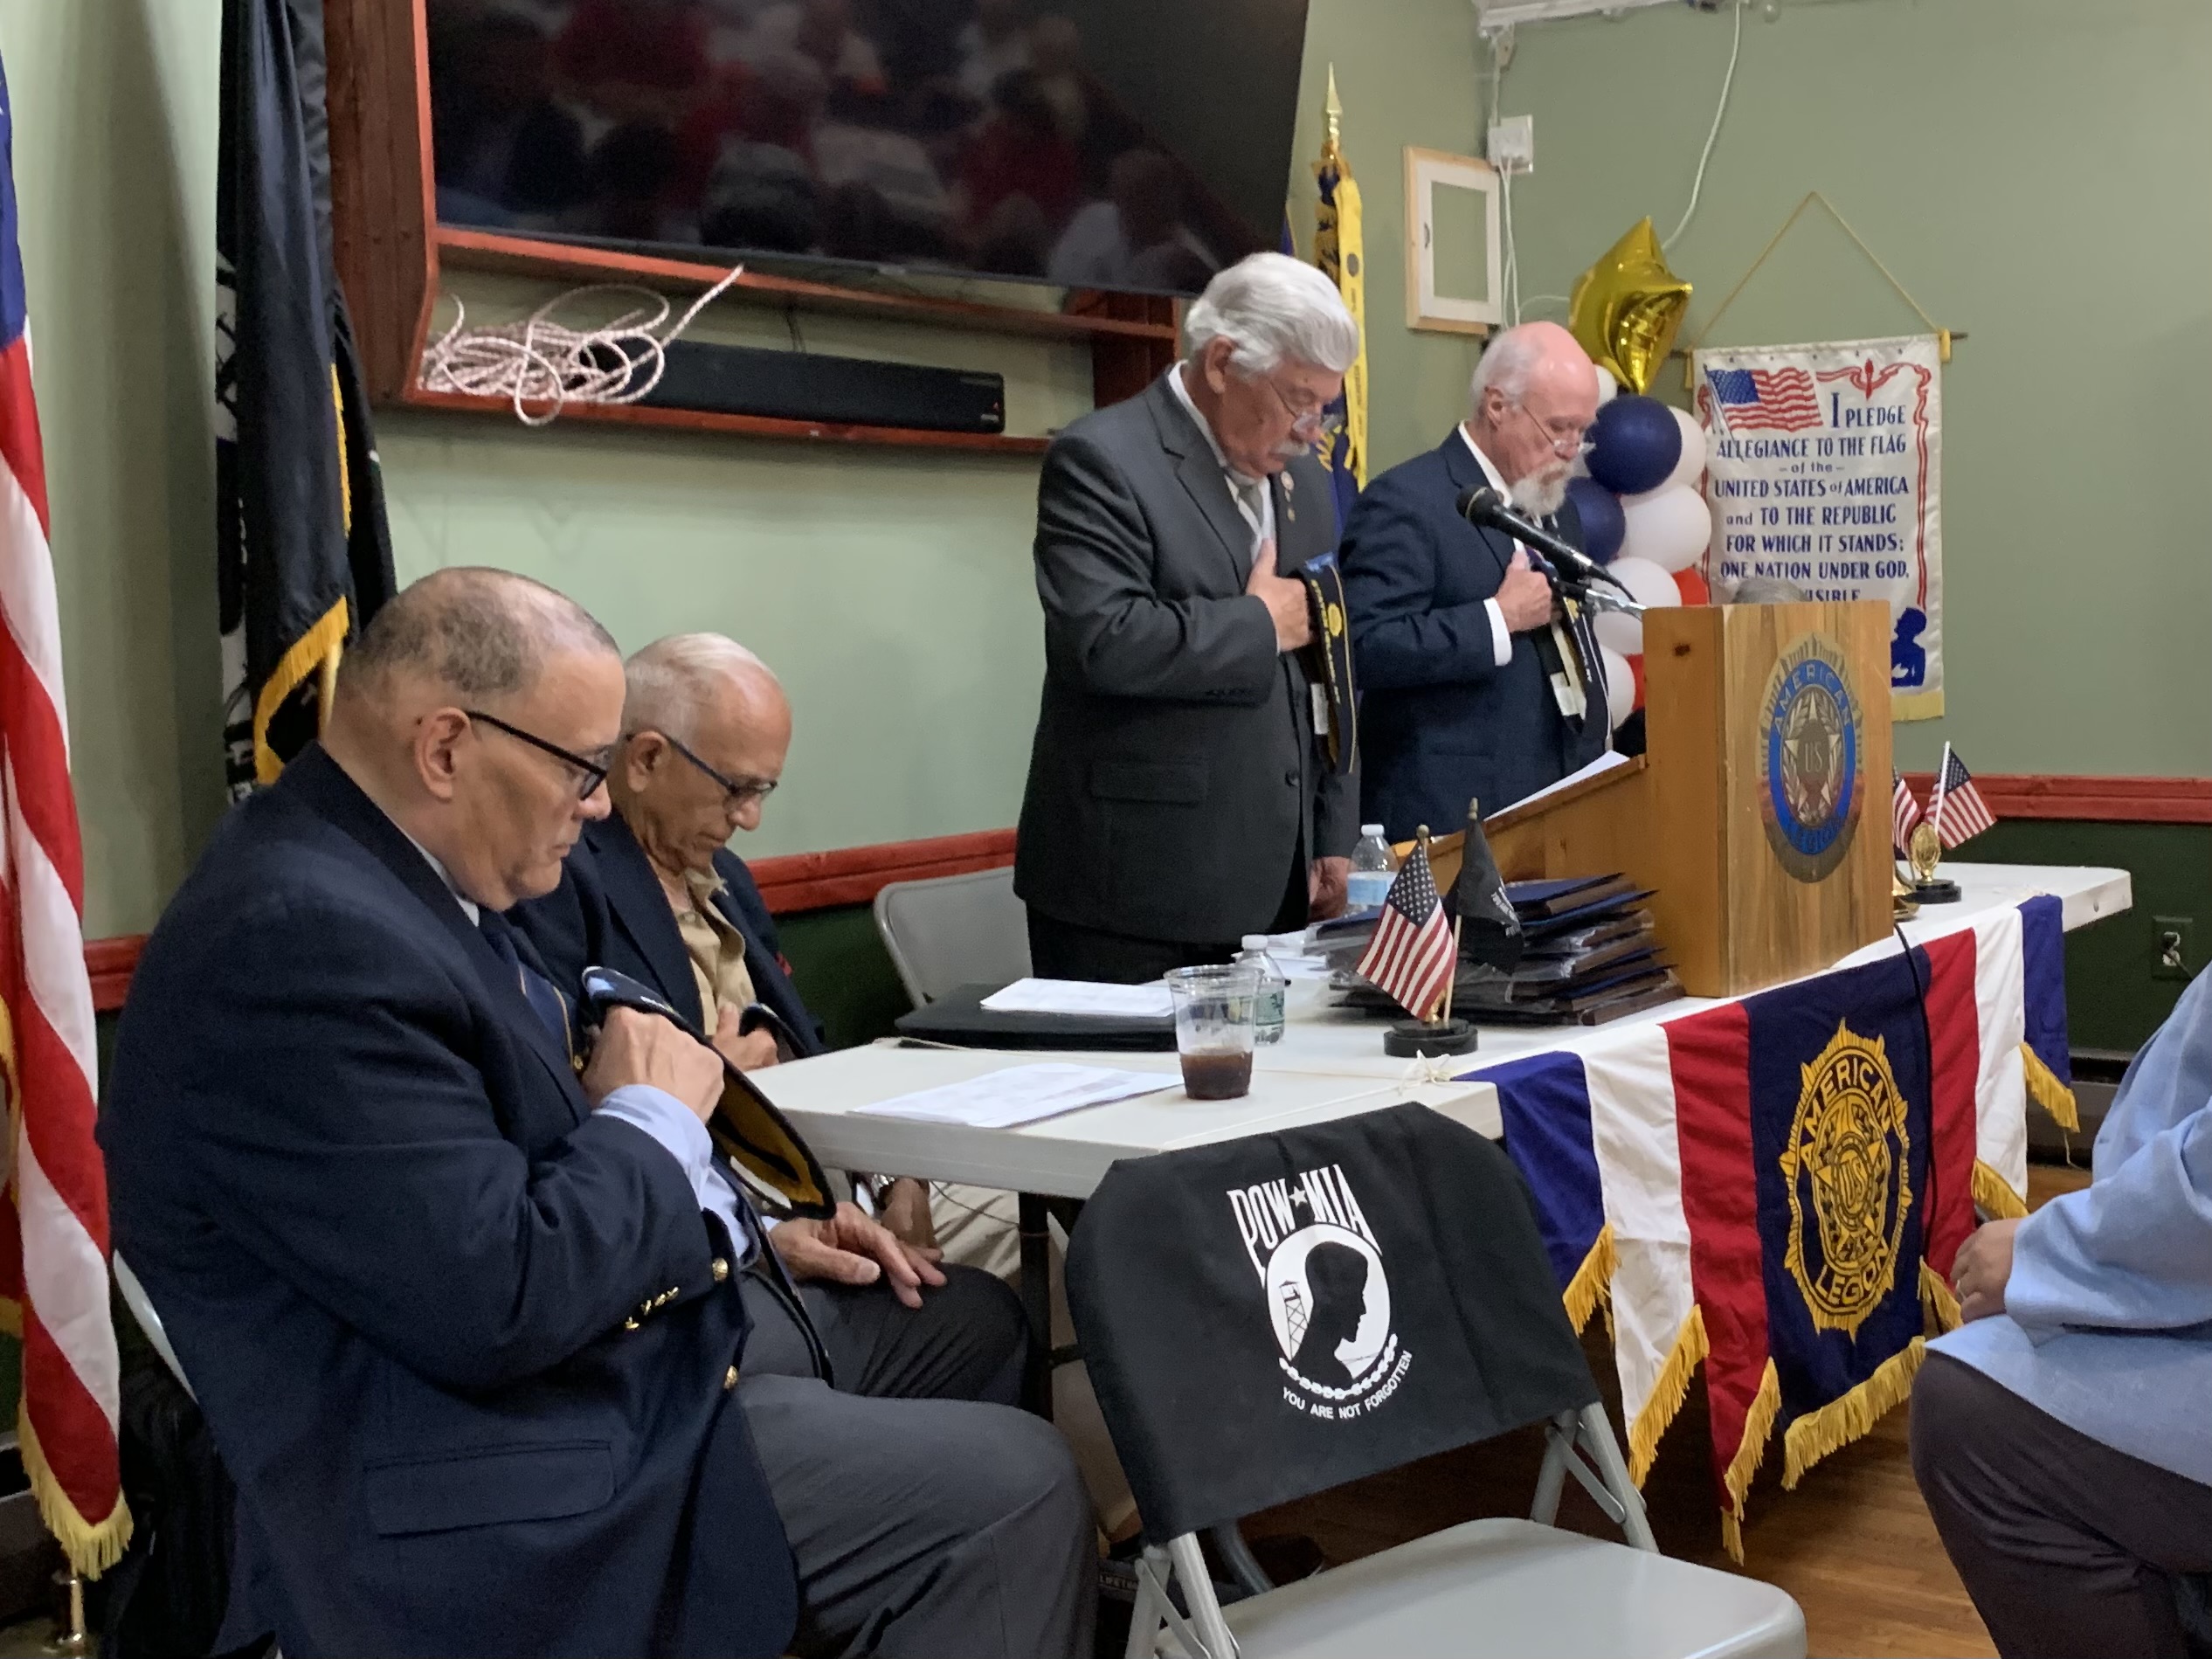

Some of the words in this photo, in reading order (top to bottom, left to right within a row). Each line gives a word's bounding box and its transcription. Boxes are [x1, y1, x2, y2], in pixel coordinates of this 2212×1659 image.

[1831, 391, 1840, 428] I
[1845, 404, 1906, 428] PLEDGE
[1717, 439, 1809, 459] ALLEGIANCE
[1816, 437, 1833, 457] TO
[1838, 437, 1866, 457] THE
[1870, 433, 1906, 456] FLAG
[1811, 461, 1833, 473] the
[1715, 479, 1770, 498] UNITED
[1773, 478, 1826, 497] STATES
[1844, 476, 1909, 496] AMERICA
[1726, 511, 1752, 525] and
[1760, 506, 1779, 525] TO
[1786, 506, 1815, 525] THE
[1821, 503, 1896, 525] REPUBLIC
[1726, 534, 1755, 553] FOR
[1761, 534, 1811, 553] WHICH
[1819, 534, 1833, 553] IT
[1720, 561, 1748, 578] ONE
[1755, 561, 1811, 579] NATION
[1819, 561, 1870, 580] UNDER
[1774, 663, 1851, 736] AMERICAN
[1804, 743, 1823, 773] US
[1801, 1057, 1891, 1173] AMERICAN
[1841, 1158, 1866, 1206] US
[1227, 1178, 1296, 1290] POW
[1299, 1164, 1384, 1256] MIA
[1282, 1386, 1306, 1410] YOU
[1310, 1403, 1334, 1420] ARE
[1338, 1402, 1361, 1420] NOT
[1364, 1350, 1413, 1412] FORGOTTEN
